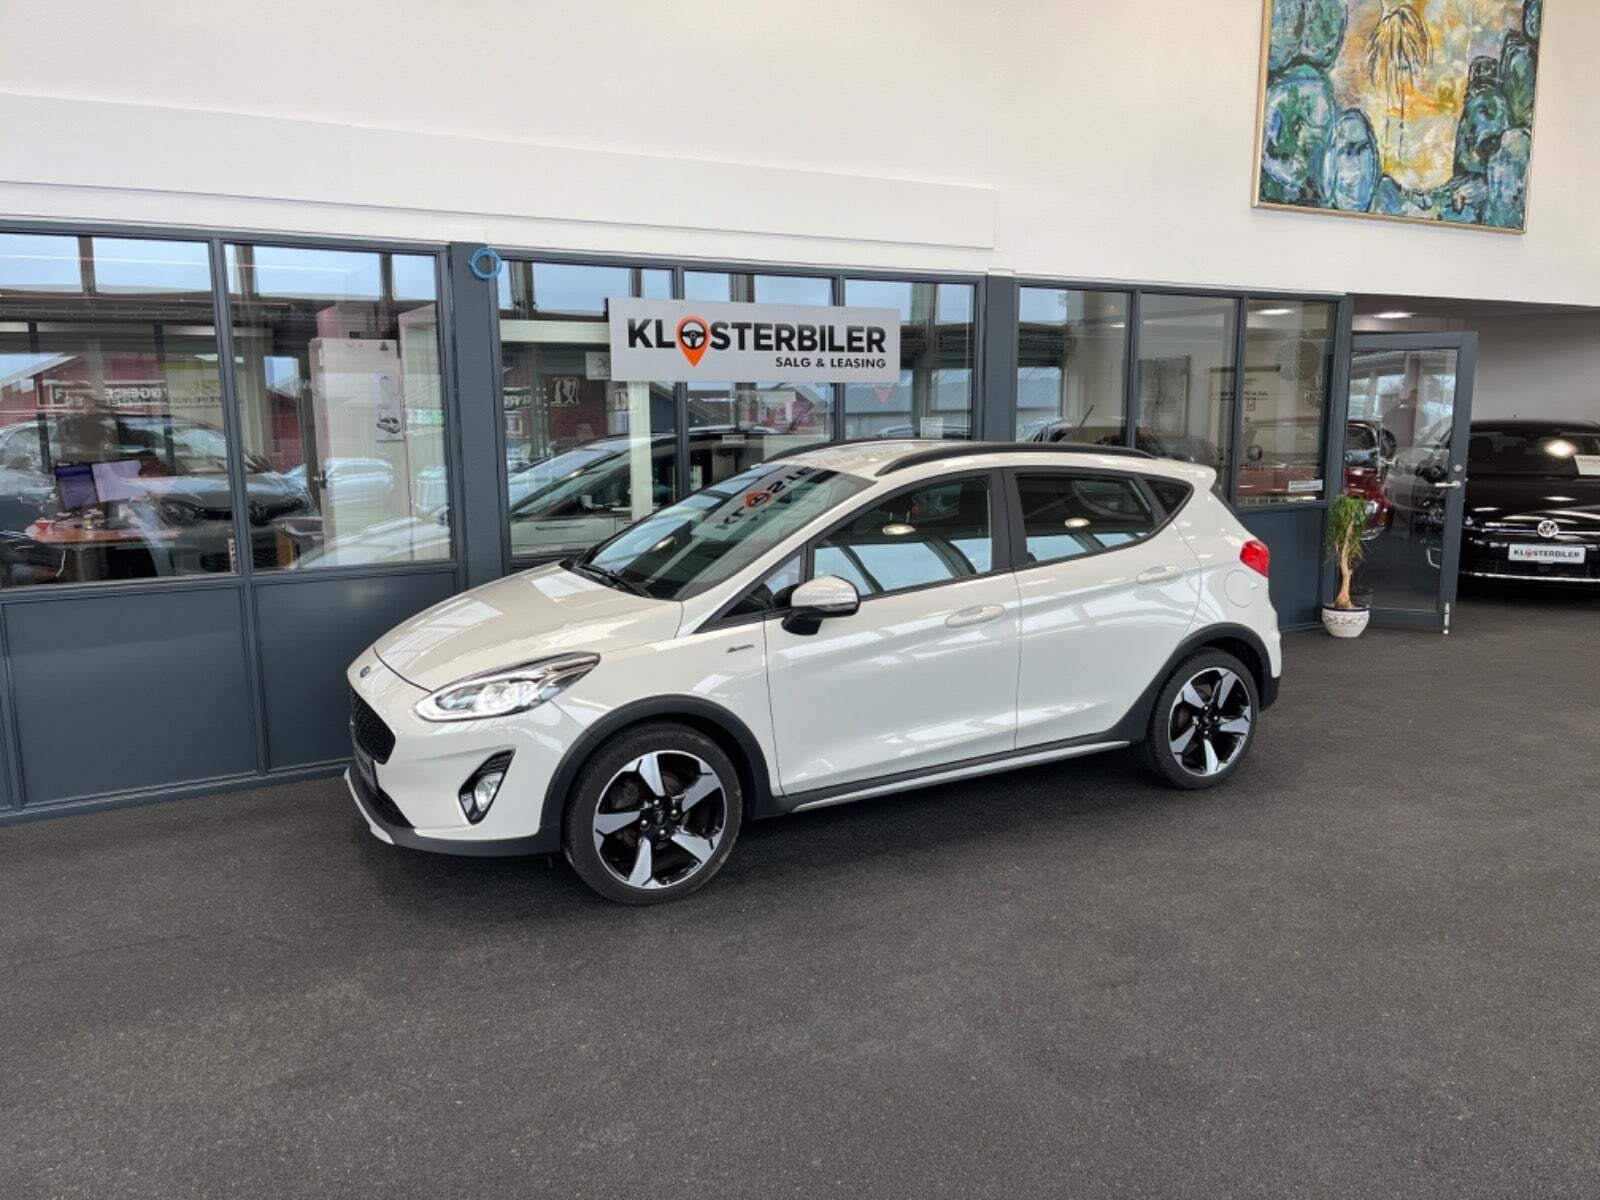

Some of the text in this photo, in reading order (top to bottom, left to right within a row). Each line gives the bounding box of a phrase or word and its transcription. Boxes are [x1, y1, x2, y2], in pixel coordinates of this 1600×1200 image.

[628, 316, 886, 356] KLOSTERBILER
[775, 357, 887, 369] SALG & LEASING
